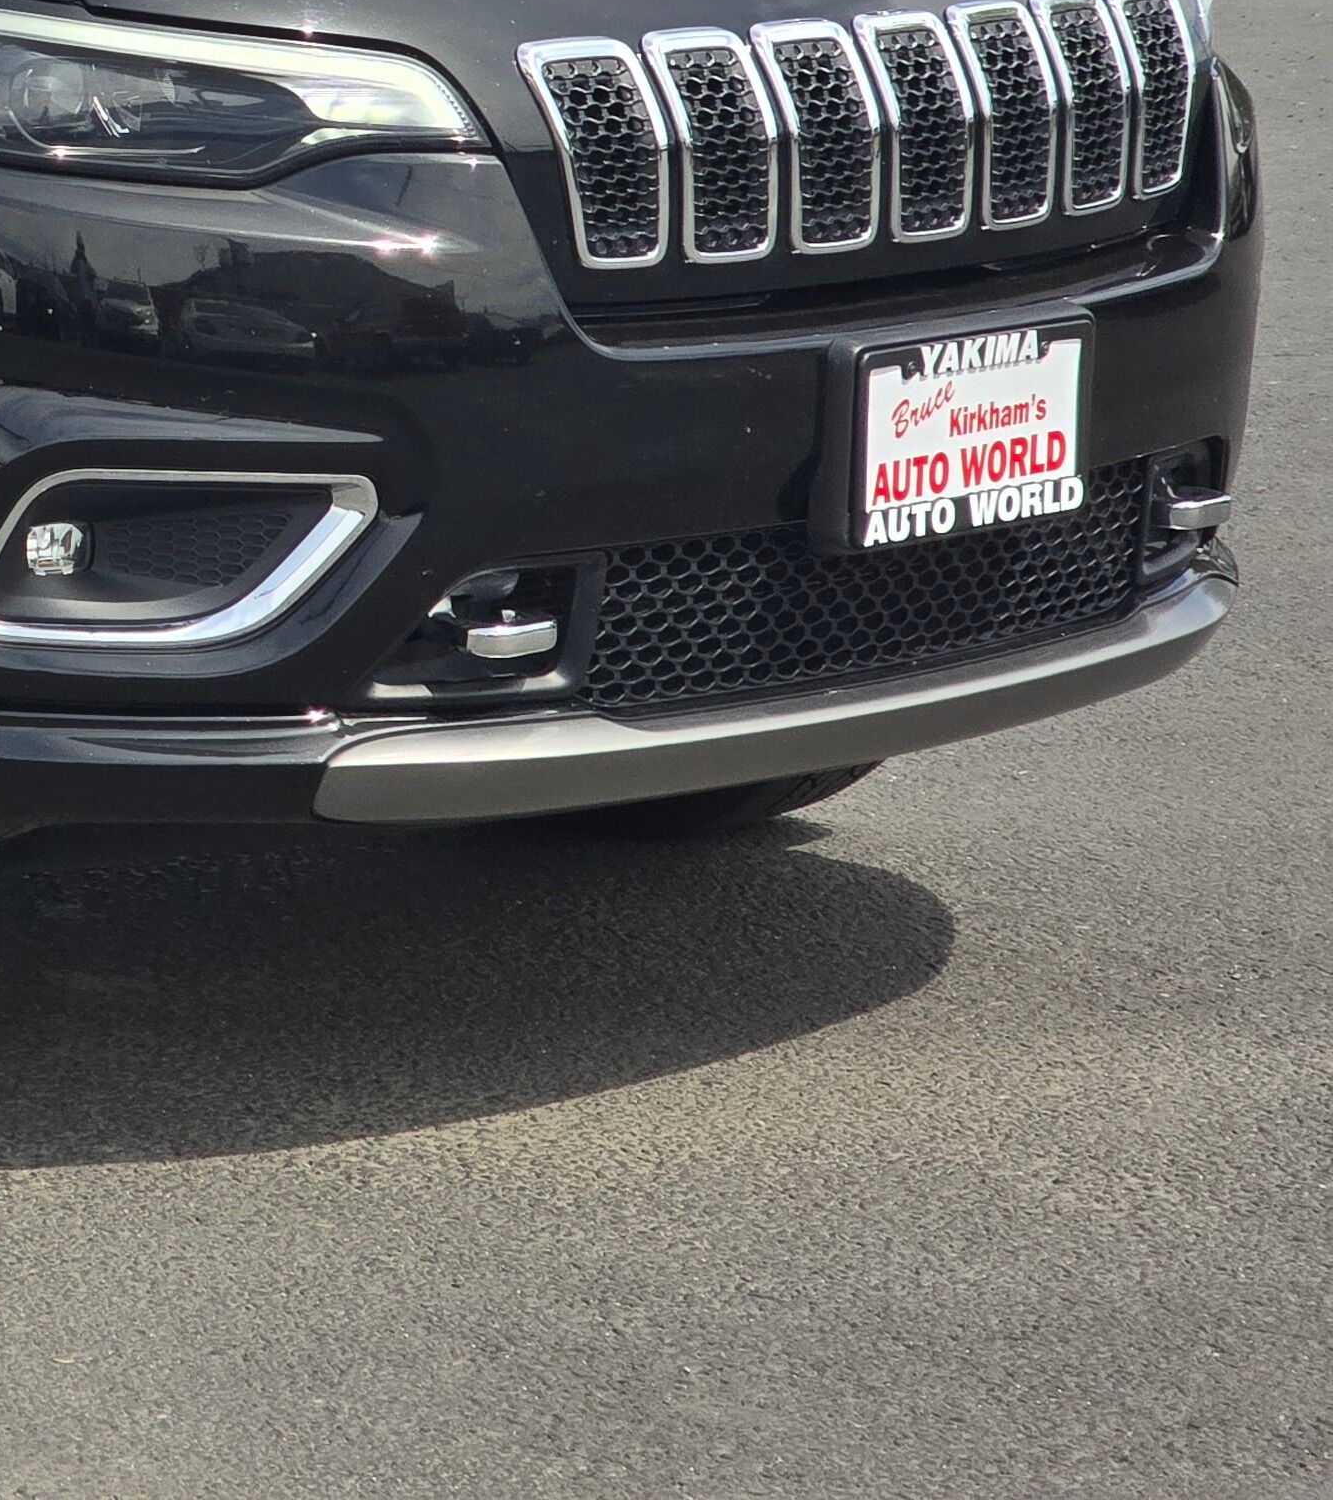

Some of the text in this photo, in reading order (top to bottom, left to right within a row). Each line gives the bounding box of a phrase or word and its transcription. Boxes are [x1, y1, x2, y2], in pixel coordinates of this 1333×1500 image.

[918, 328, 1039, 378] YAKIMA
[890, 380, 1047, 439] Bruce Kirkham's
[871, 430, 1067, 506] AUTO WORLD
[863, 475, 1085, 548] AUTO WORLD
